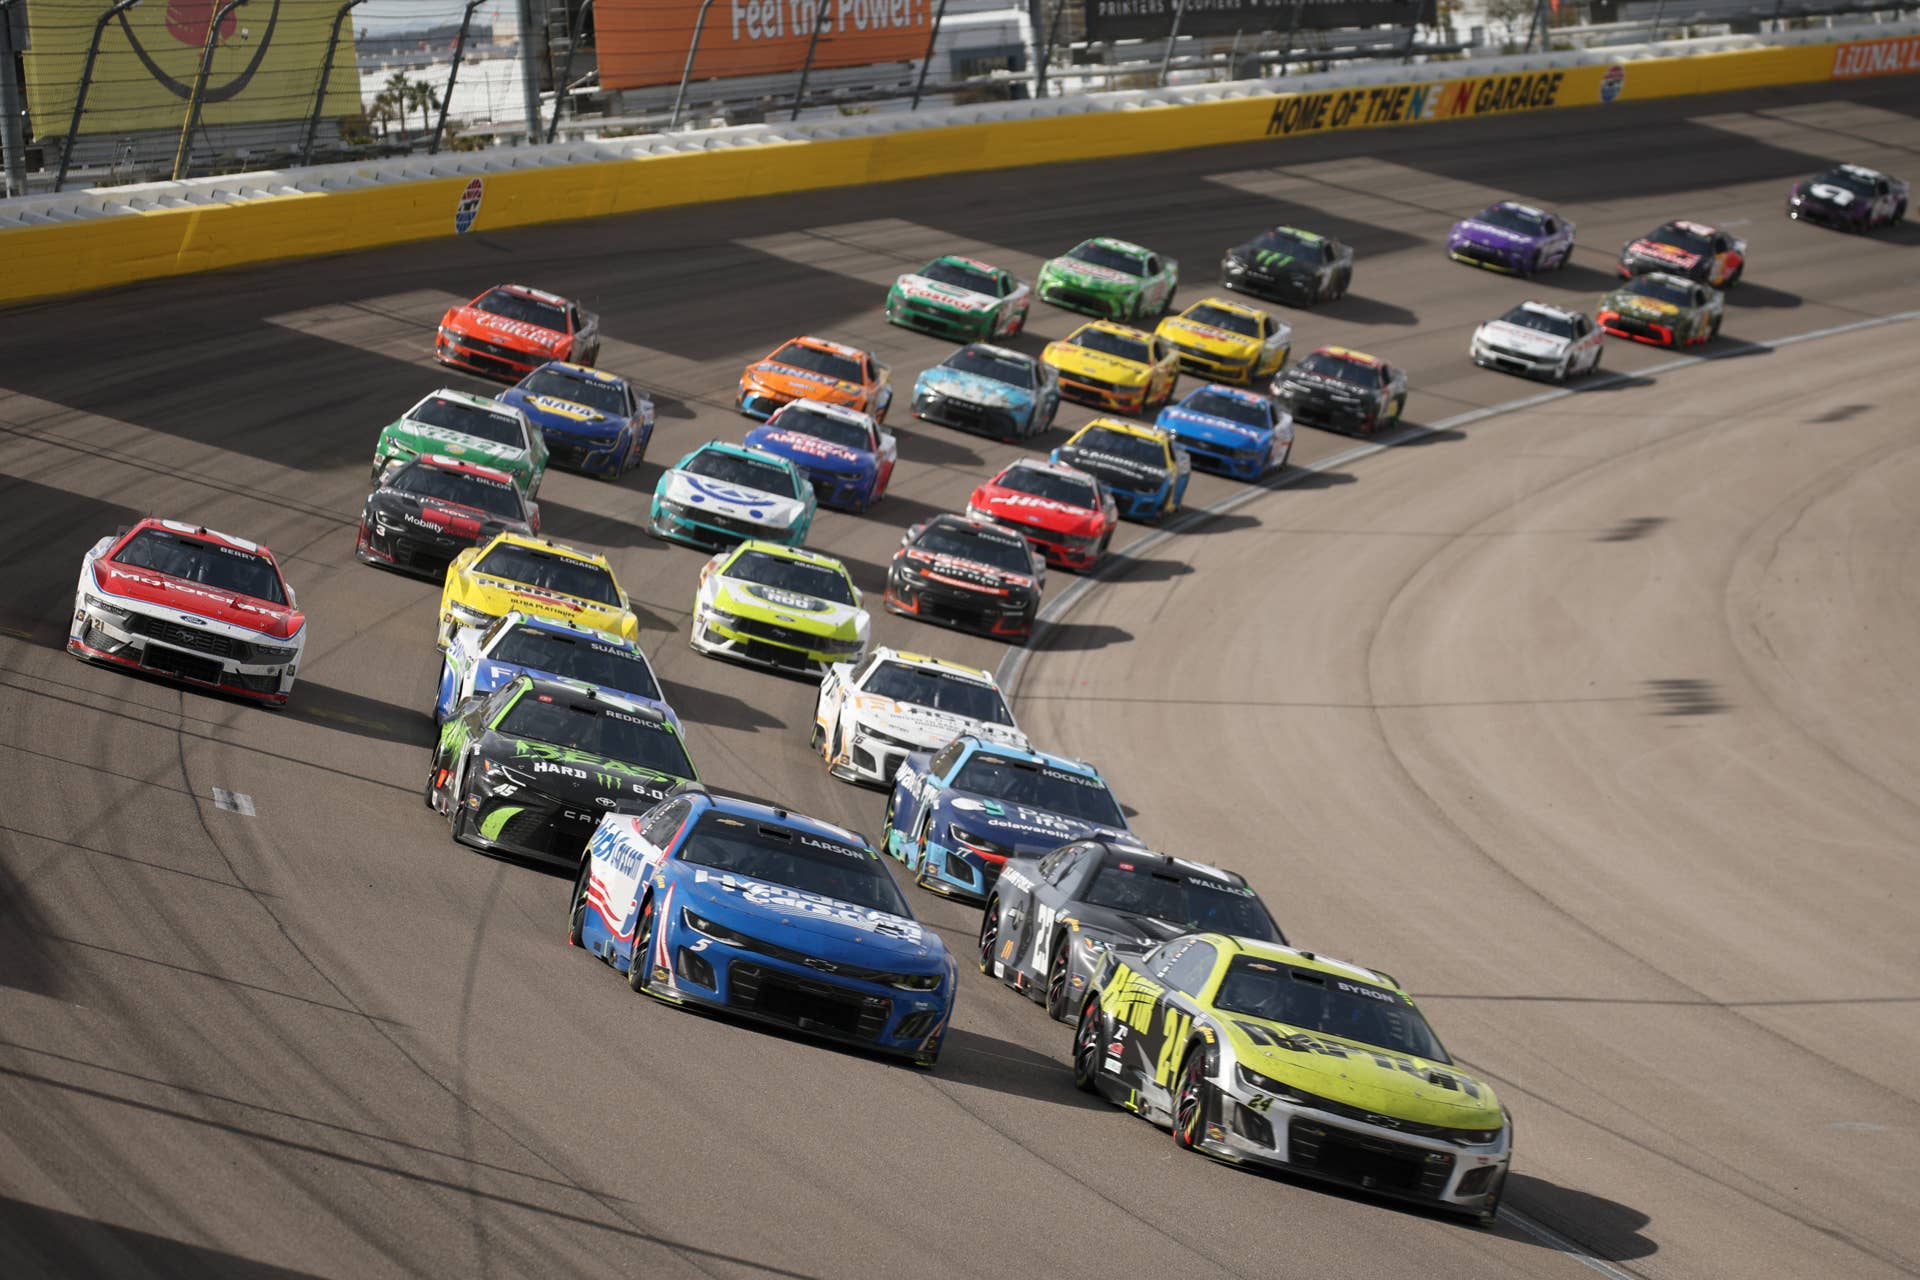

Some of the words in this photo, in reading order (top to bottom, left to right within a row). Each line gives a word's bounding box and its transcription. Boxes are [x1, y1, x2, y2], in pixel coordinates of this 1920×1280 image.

[732, 0, 784, 41] Feel
[791, 0, 833, 35] the
[839, 0, 924, 33] Power!
[1266, 93, 1327, 135] HOME
[1330, 88, 1362, 128] OF
[1363, 84, 1412, 124] THE
[1473, 73, 1564, 114] GARAGE
[541, 398, 591, 416] NAPA
[476, 476, 512, 492] DILLON
[376, 524, 386, 537] 3
[404, 513, 444, 533] Mobility
[220, 546, 256, 561] BERRY
[559, 556, 600, 571] LOGANO
[510, 598, 535, 608] ULTRA
[535, 602, 576, 619] PLATINUM
[94, 619, 105, 632] 21
[591, 641, 642, 662] SUÁREZ
[605, 708, 663, 731] REDDICK
[534, 761, 587, 780] HARD
[493, 781, 519, 798] 45
[800, 835, 866, 861] LARSON
[689, 938, 712, 951] 5
[1336, 981, 1395, 1005] BYRON
[1247, 1093, 1273, 1112] 24
